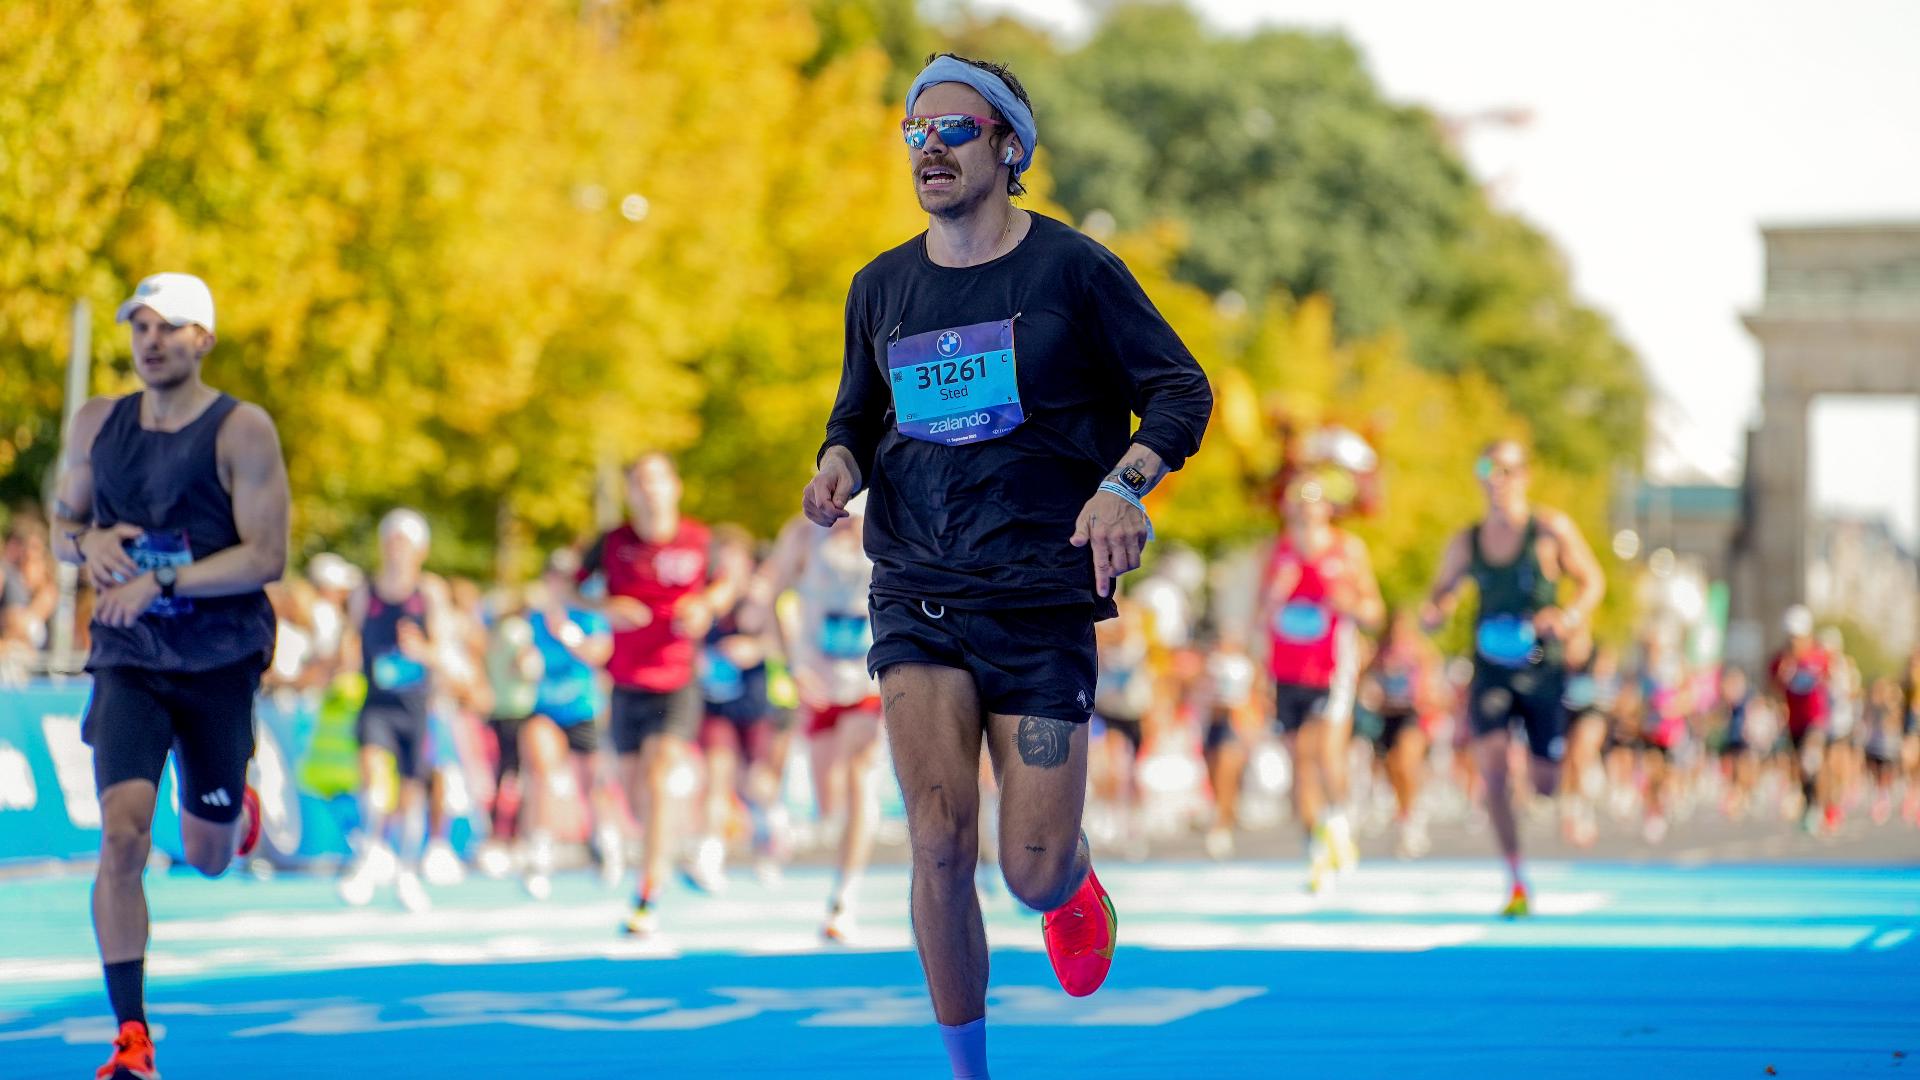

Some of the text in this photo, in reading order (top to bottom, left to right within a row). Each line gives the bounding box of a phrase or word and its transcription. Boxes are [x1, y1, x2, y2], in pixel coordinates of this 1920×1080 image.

[1001, 354, 1008, 363] C
[915, 356, 986, 390] 31261
[940, 385, 968, 401] Sted
[929, 411, 991, 434] zalando
